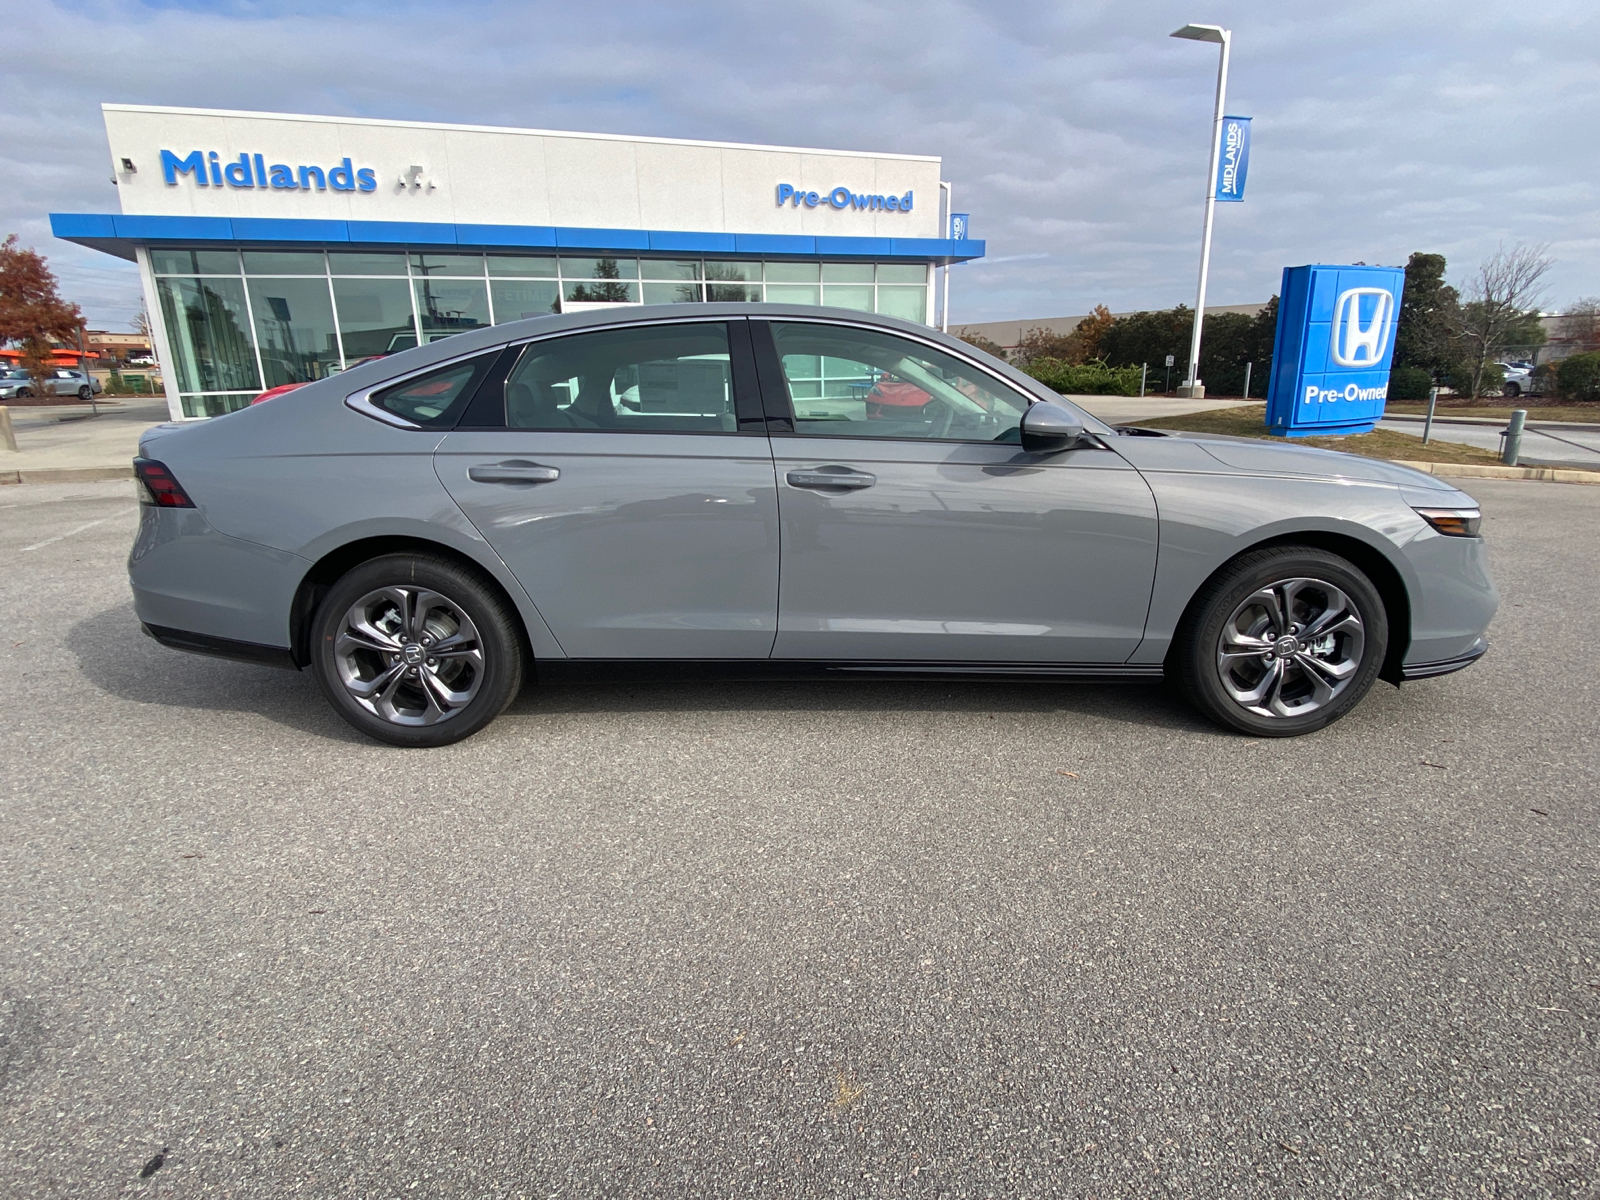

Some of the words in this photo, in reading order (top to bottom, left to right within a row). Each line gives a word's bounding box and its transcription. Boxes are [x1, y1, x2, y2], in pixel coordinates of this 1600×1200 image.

[160, 149, 378, 193] Midlands
[1222, 122, 1239, 193] MIDLANDS
[777, 183, 914, 212] Pre-Owned
[1304, 381, 1389, 405] Pre-Owned
[1204, 594, 1233, 643] KINERGY
